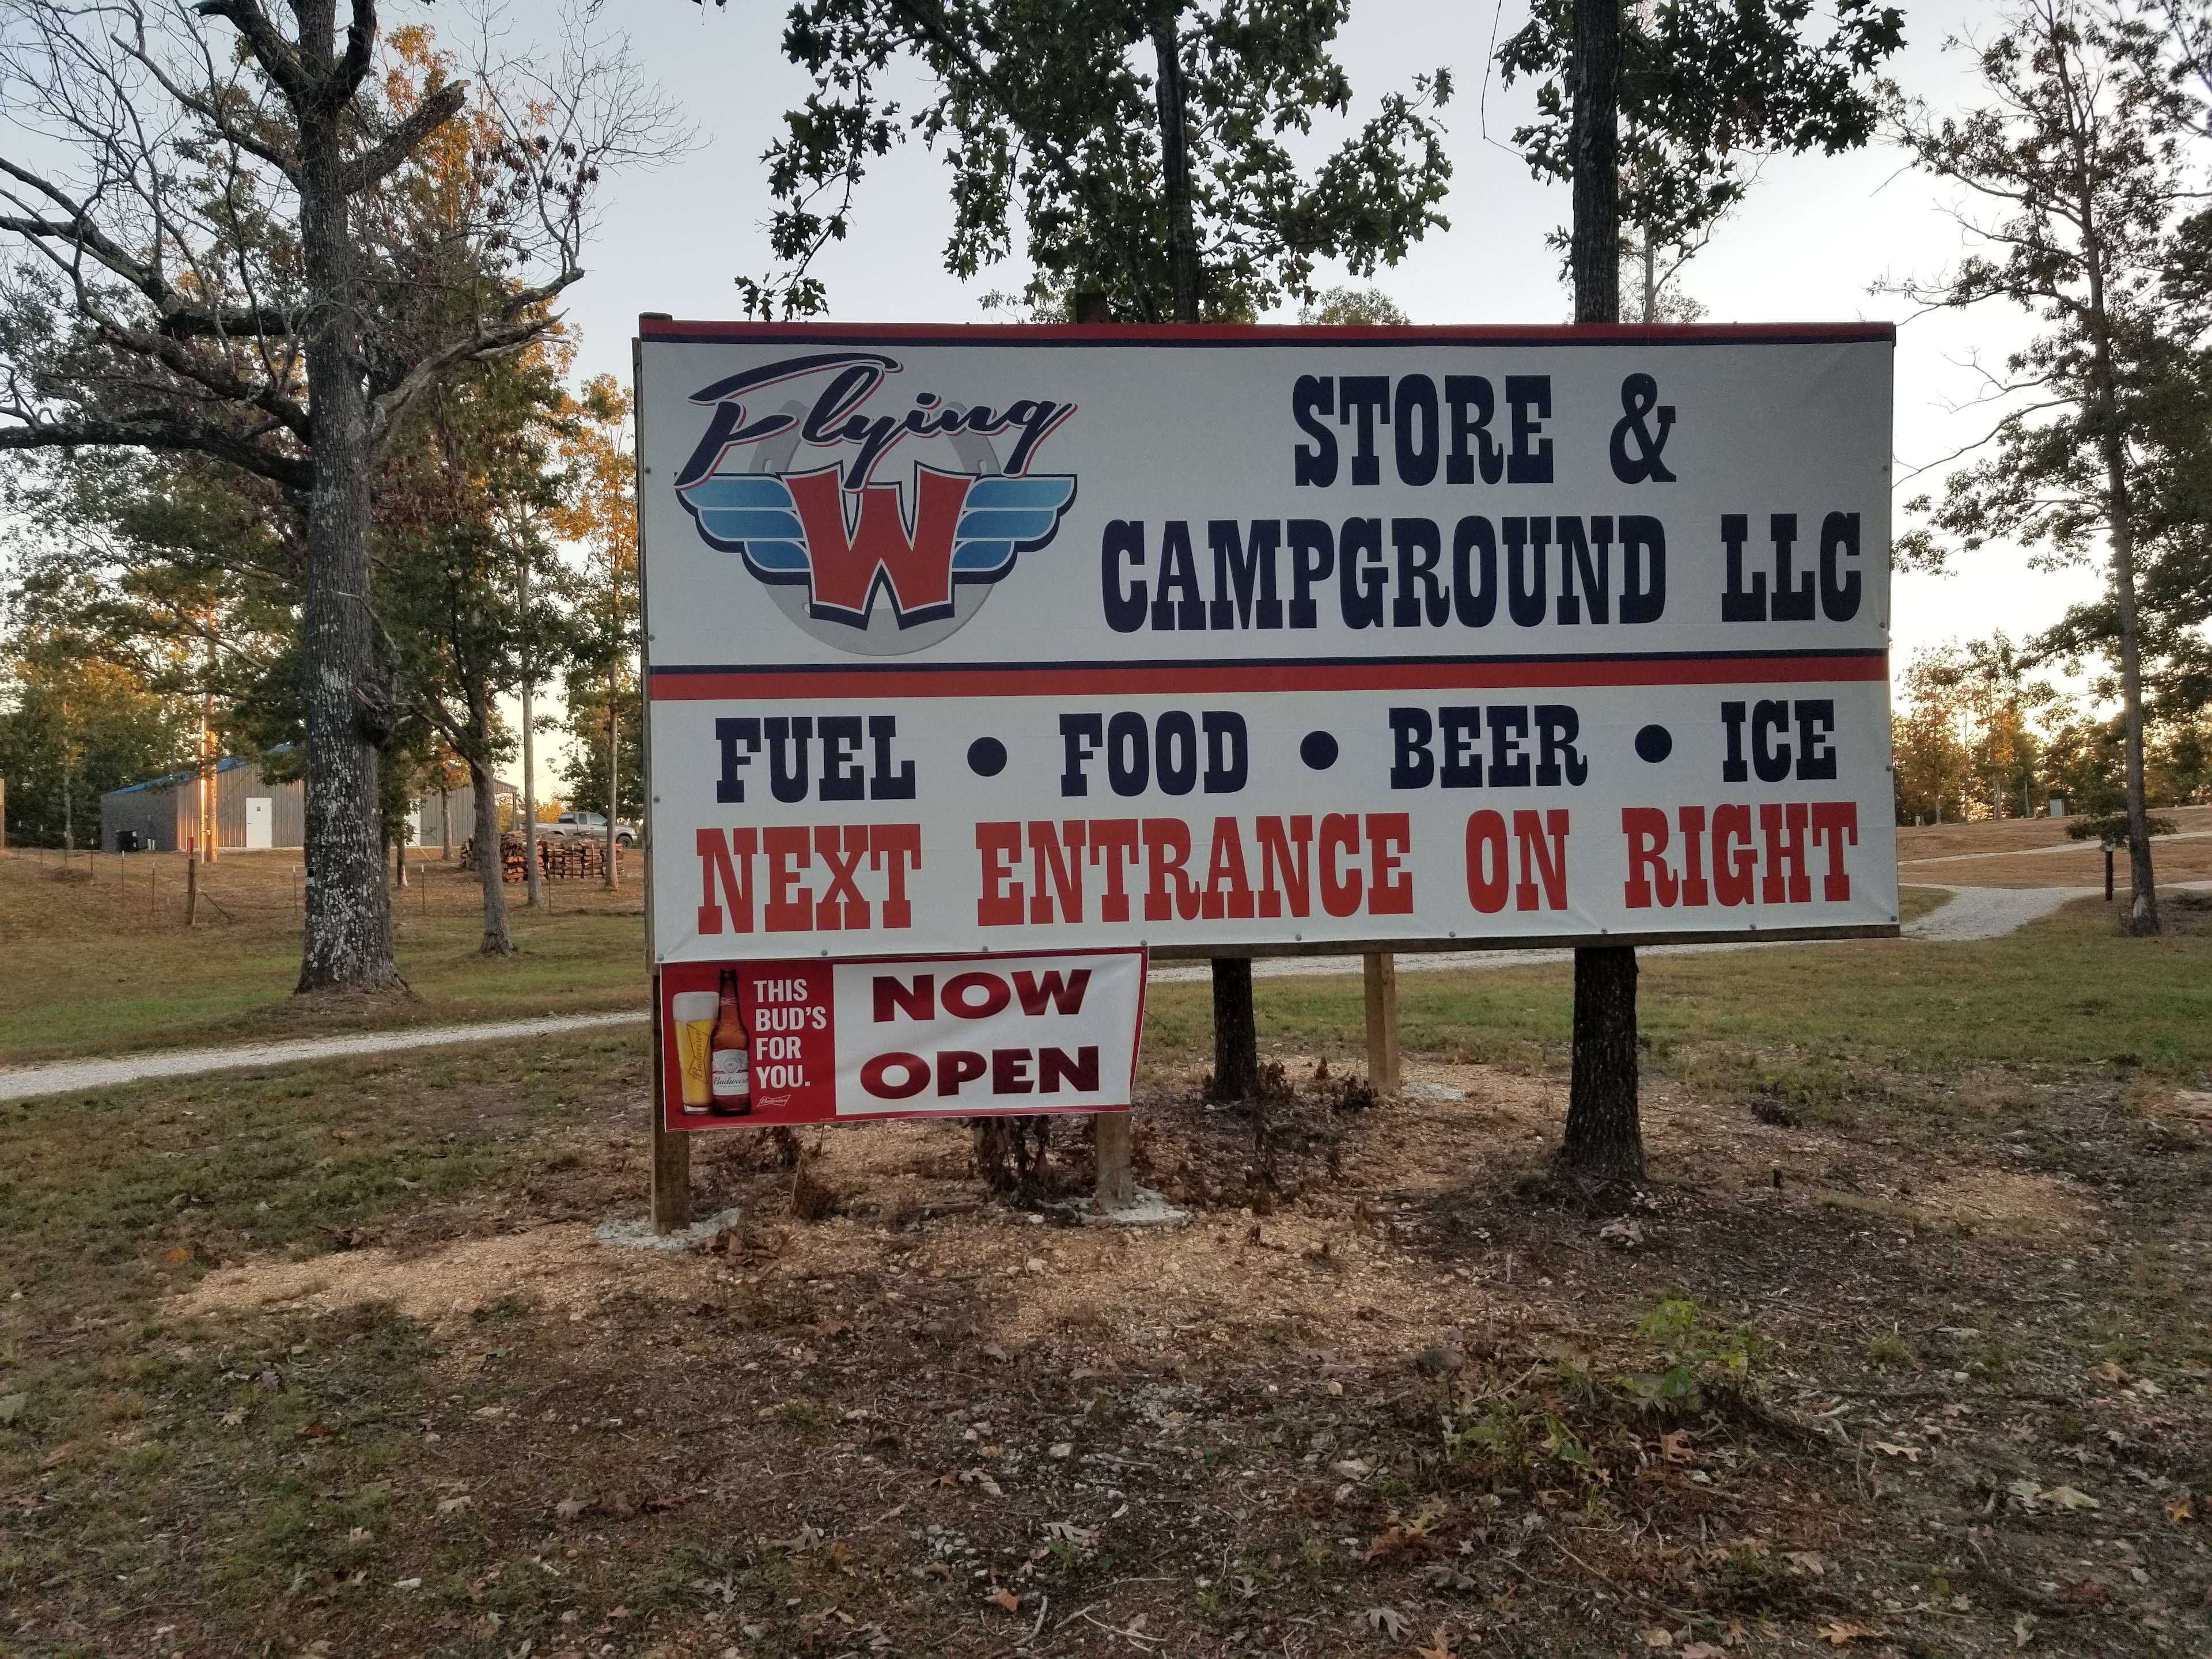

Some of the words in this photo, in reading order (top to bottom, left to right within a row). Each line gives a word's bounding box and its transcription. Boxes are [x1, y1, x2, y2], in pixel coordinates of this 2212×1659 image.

[675, 353, 1078, 493] Flying
[1292, 373, 1554, 487] STORE
[1610, 373, 1676, 484] &
[775, 460, 981, 631] W
[1101, 515, 1667, 633] CAMPGROUND
[1721, 512, 1862, 622] LLC
[715, 715, 916, 803] FUEL
[1059, 710, 1249, 797] FOOD
[1388, 704, 1588, 789] BEER
[1721, 699, 1837, 782] ICE
[696, 823, 921, 935] NEXT
[975, 813, 1414, 926] ENTRANCE
[1465, 809, 1569, 914] ON
[1622, 802, 1858, 908] RIGHT
[753, 979, 808, 1003] THIS
[873, 969, 1092, 1022] NOW
[755, 1006, 827, 1032] BUD'S
[692, 1031, 702, 1080] Budweiser
[756, 1036, 801, 1060] FOR
[860, 1046, 1099, 1100] OPEN
[756, 1065, 811, 1089] YOU.
